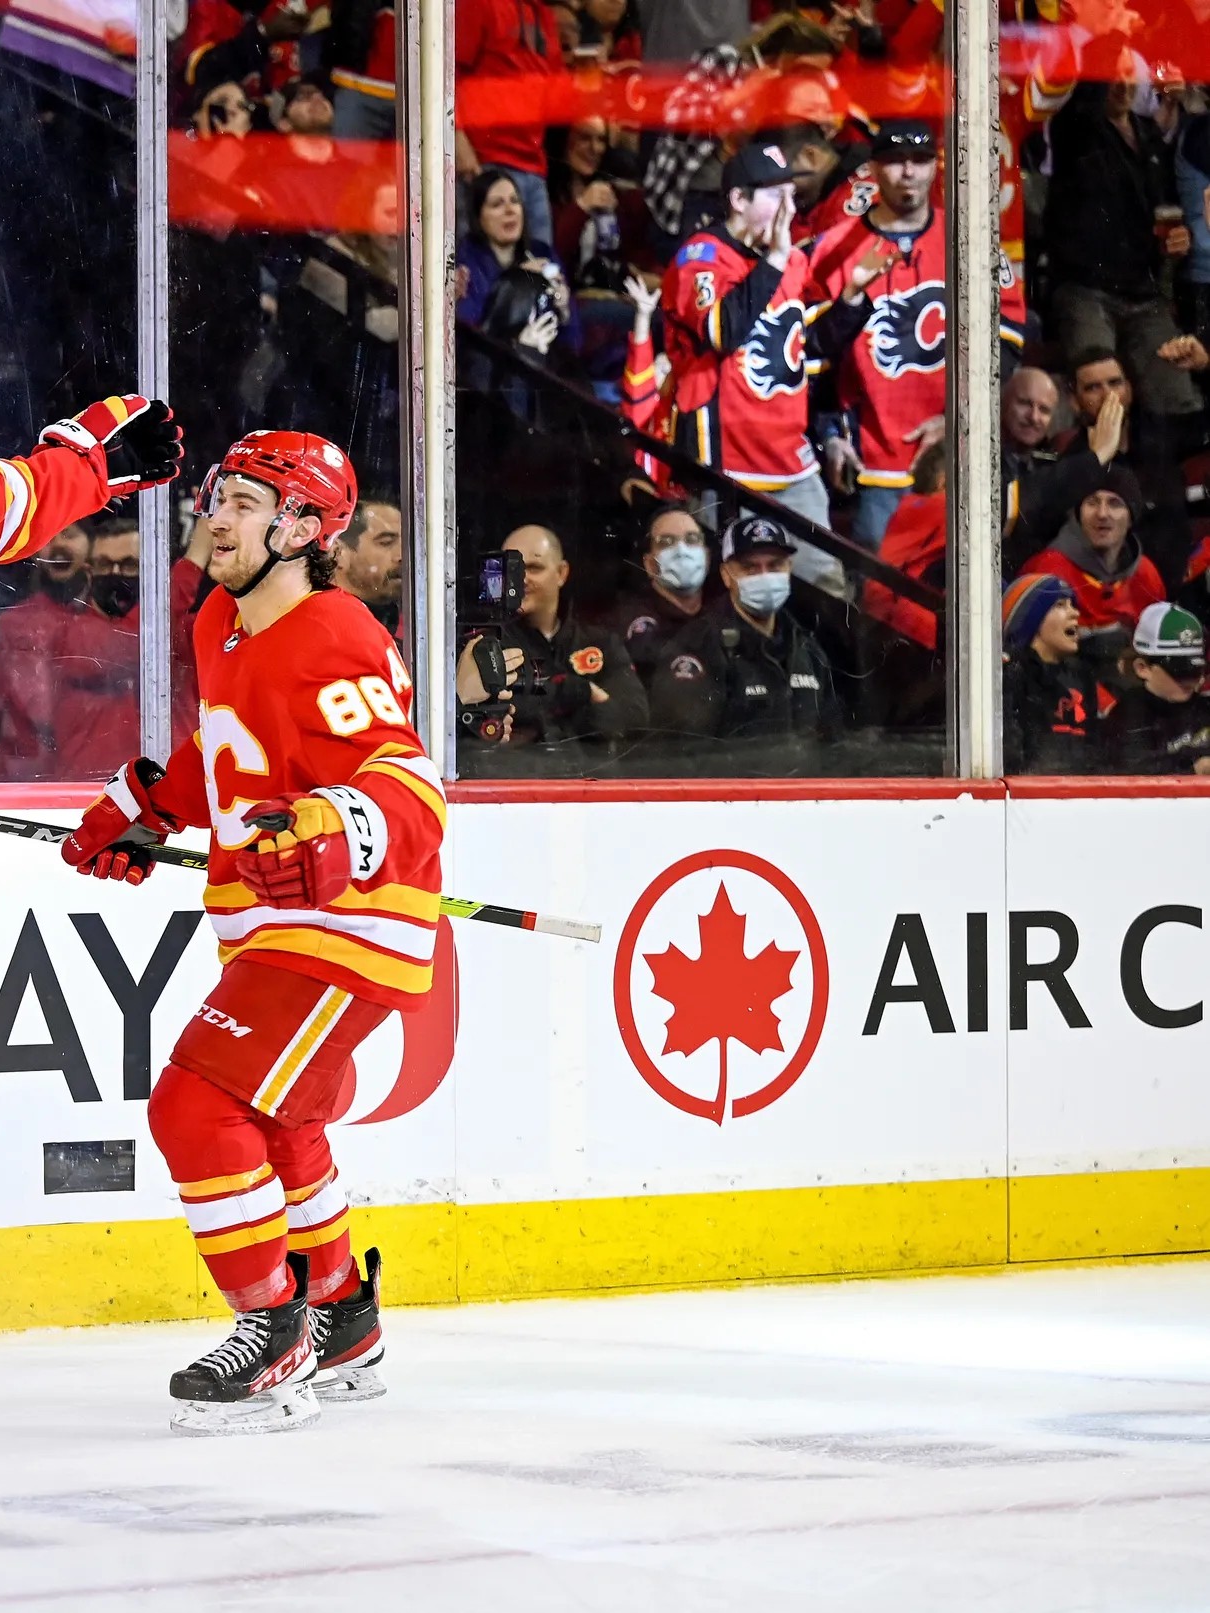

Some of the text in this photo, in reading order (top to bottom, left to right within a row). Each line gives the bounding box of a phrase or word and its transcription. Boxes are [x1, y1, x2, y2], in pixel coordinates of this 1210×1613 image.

[229, 446, 254, 456] CCM
[316, 675, 406, 736] 88
[327, 785, 373, 872] CCM
[862, 904, 1203, 1036] AIR C
[194, 1003, 253, 1038] CCM
[250, 1335, 312, 1393] CCM
